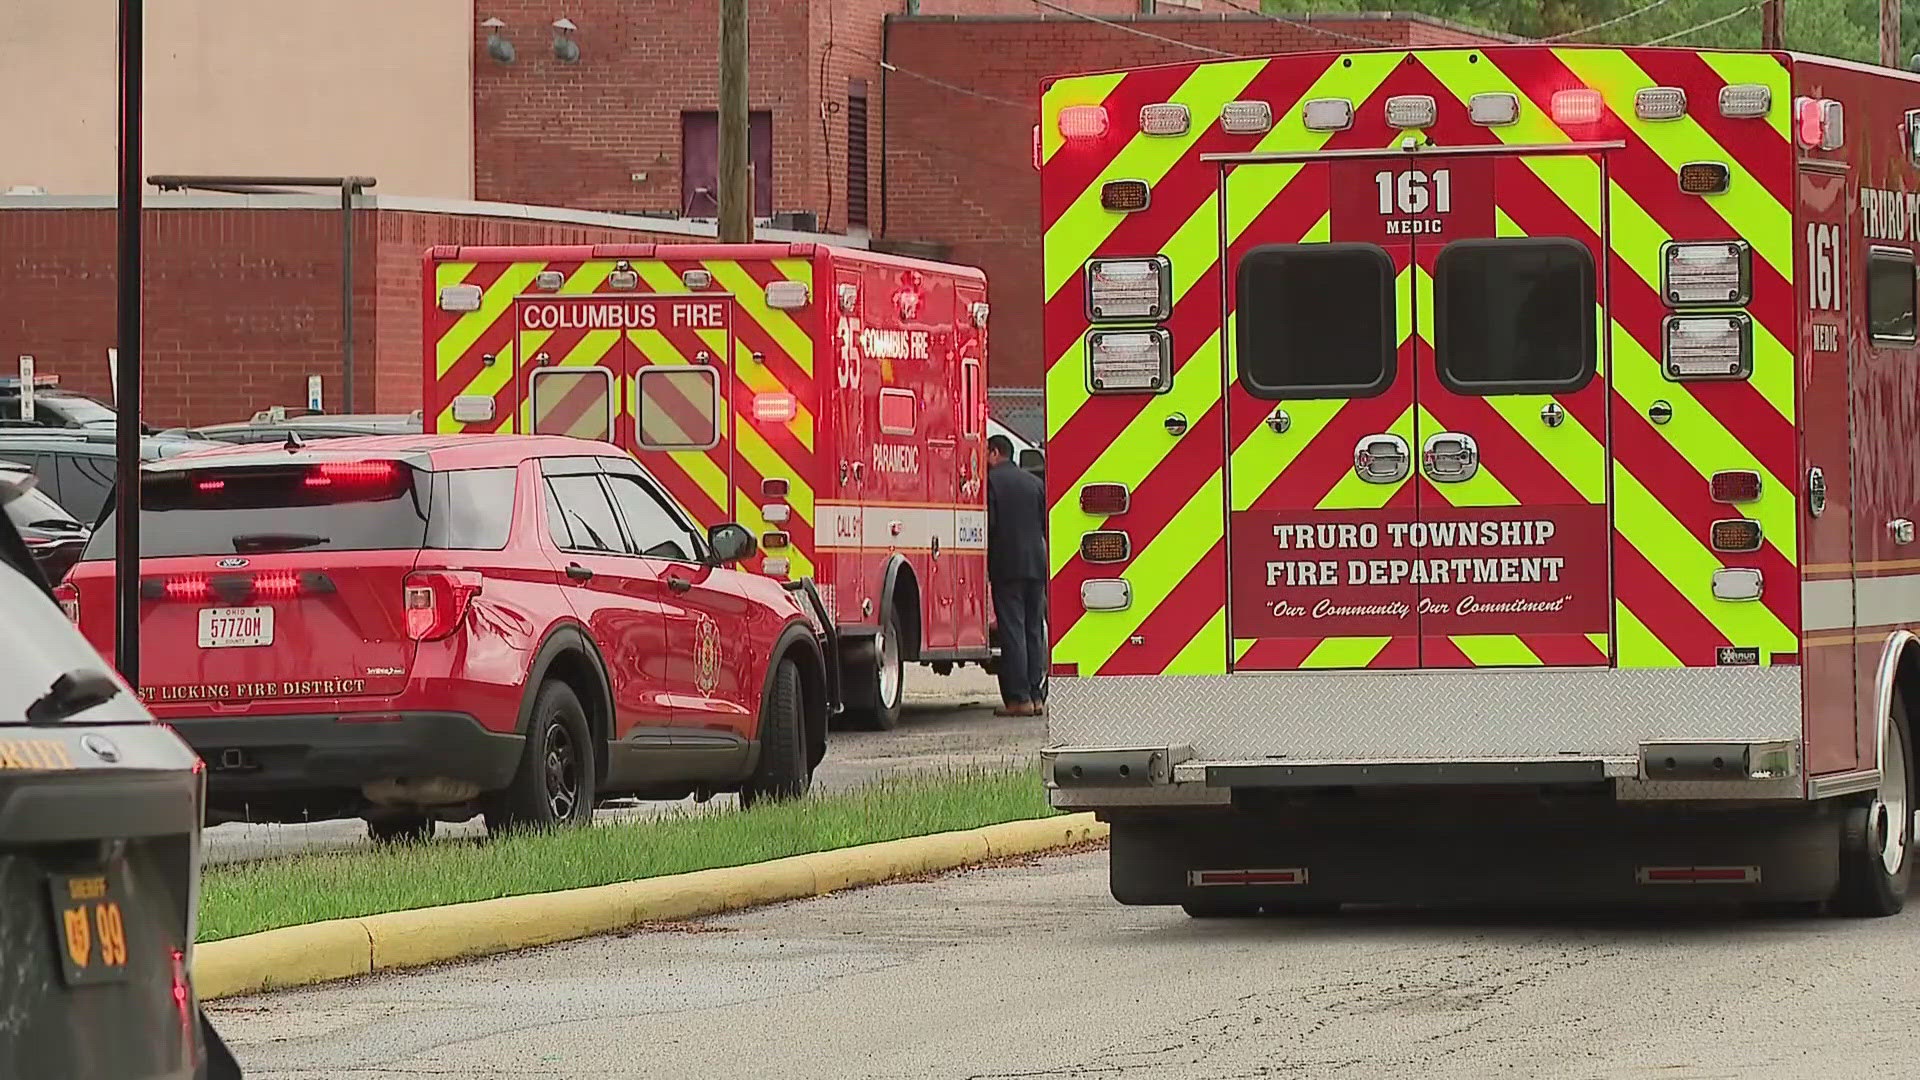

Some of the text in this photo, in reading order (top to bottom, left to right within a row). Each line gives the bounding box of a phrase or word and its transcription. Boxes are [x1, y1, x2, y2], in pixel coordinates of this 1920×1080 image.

[1375, 169, 1450, 214] 161
[1386, 219, 1442, 234] MEDIC
[1861, 187, 1905, 241] TRURO
[1806, 222, 1841, 311] 161
[523, 304, 723, 328] COLUMBUS FIRE
[863, 328, 929, 360] COLUMBUS FIRE
[1813, 324, 1839, 352] MEDIC
[837, 316, 861, 390] 35
[872, 443, 919, 474] PARAMEDIC
[837, 515, 851, 537] CALL
[1273, 520, 1555, 549] TRURO TOWNSHIP
[1266, 557, 1565, 586] FIRE DEPARTMENT
[1312, 598, 1410, 619] Community
[1418, 600, 1450, 615] Our
[138, 679, 366, 700] ST LICKING FIRE DISTRICT
